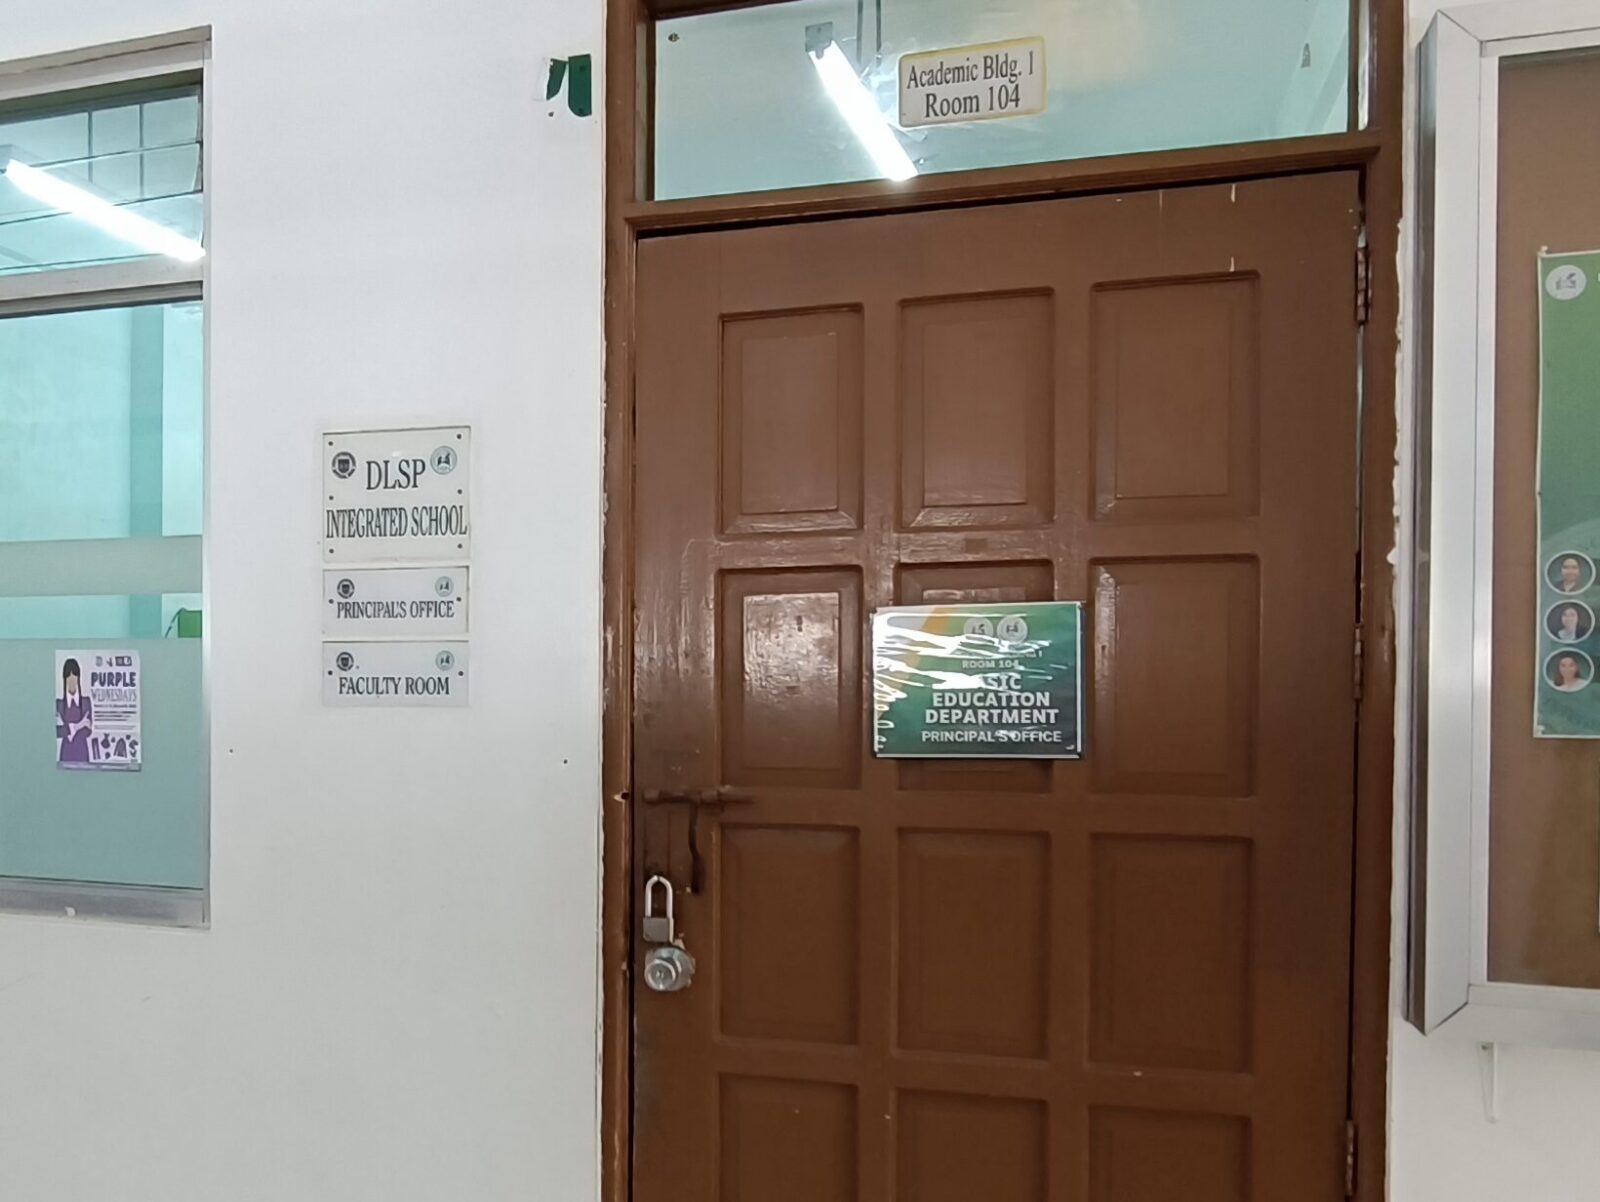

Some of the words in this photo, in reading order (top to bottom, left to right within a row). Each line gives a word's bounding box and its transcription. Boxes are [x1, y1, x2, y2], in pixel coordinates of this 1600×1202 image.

[906, 57, 978, 89] Academic
[983, 52, 1022, 84] Bldg.
[925, 93, 980, 118] Room
[988, 83, 1020, 111] 104
[365, 458, 426, 490] DLSP
[326, 507, 408, 539] INTEGRATED
[411, 505, 468, 536] SCHOOL
[336, 601, 407, 619] PRINCIPAL'S
[410, 600, 455, 618] OFFICE
[962, 660, 995, 669] ROOM
[91, 672, 137, 687] PURPLE
[338, 676, 402, 695] FACULTY
[404, 676, 450, 695] ROOM
[932, 691, 1050, 707] EDUCATION
[925, 708, 1059, 724] DEPARTMENT
[922, 730, 1008, 742] PRINCIPALS
[1012, 730, 1062, 742] OFFICE
